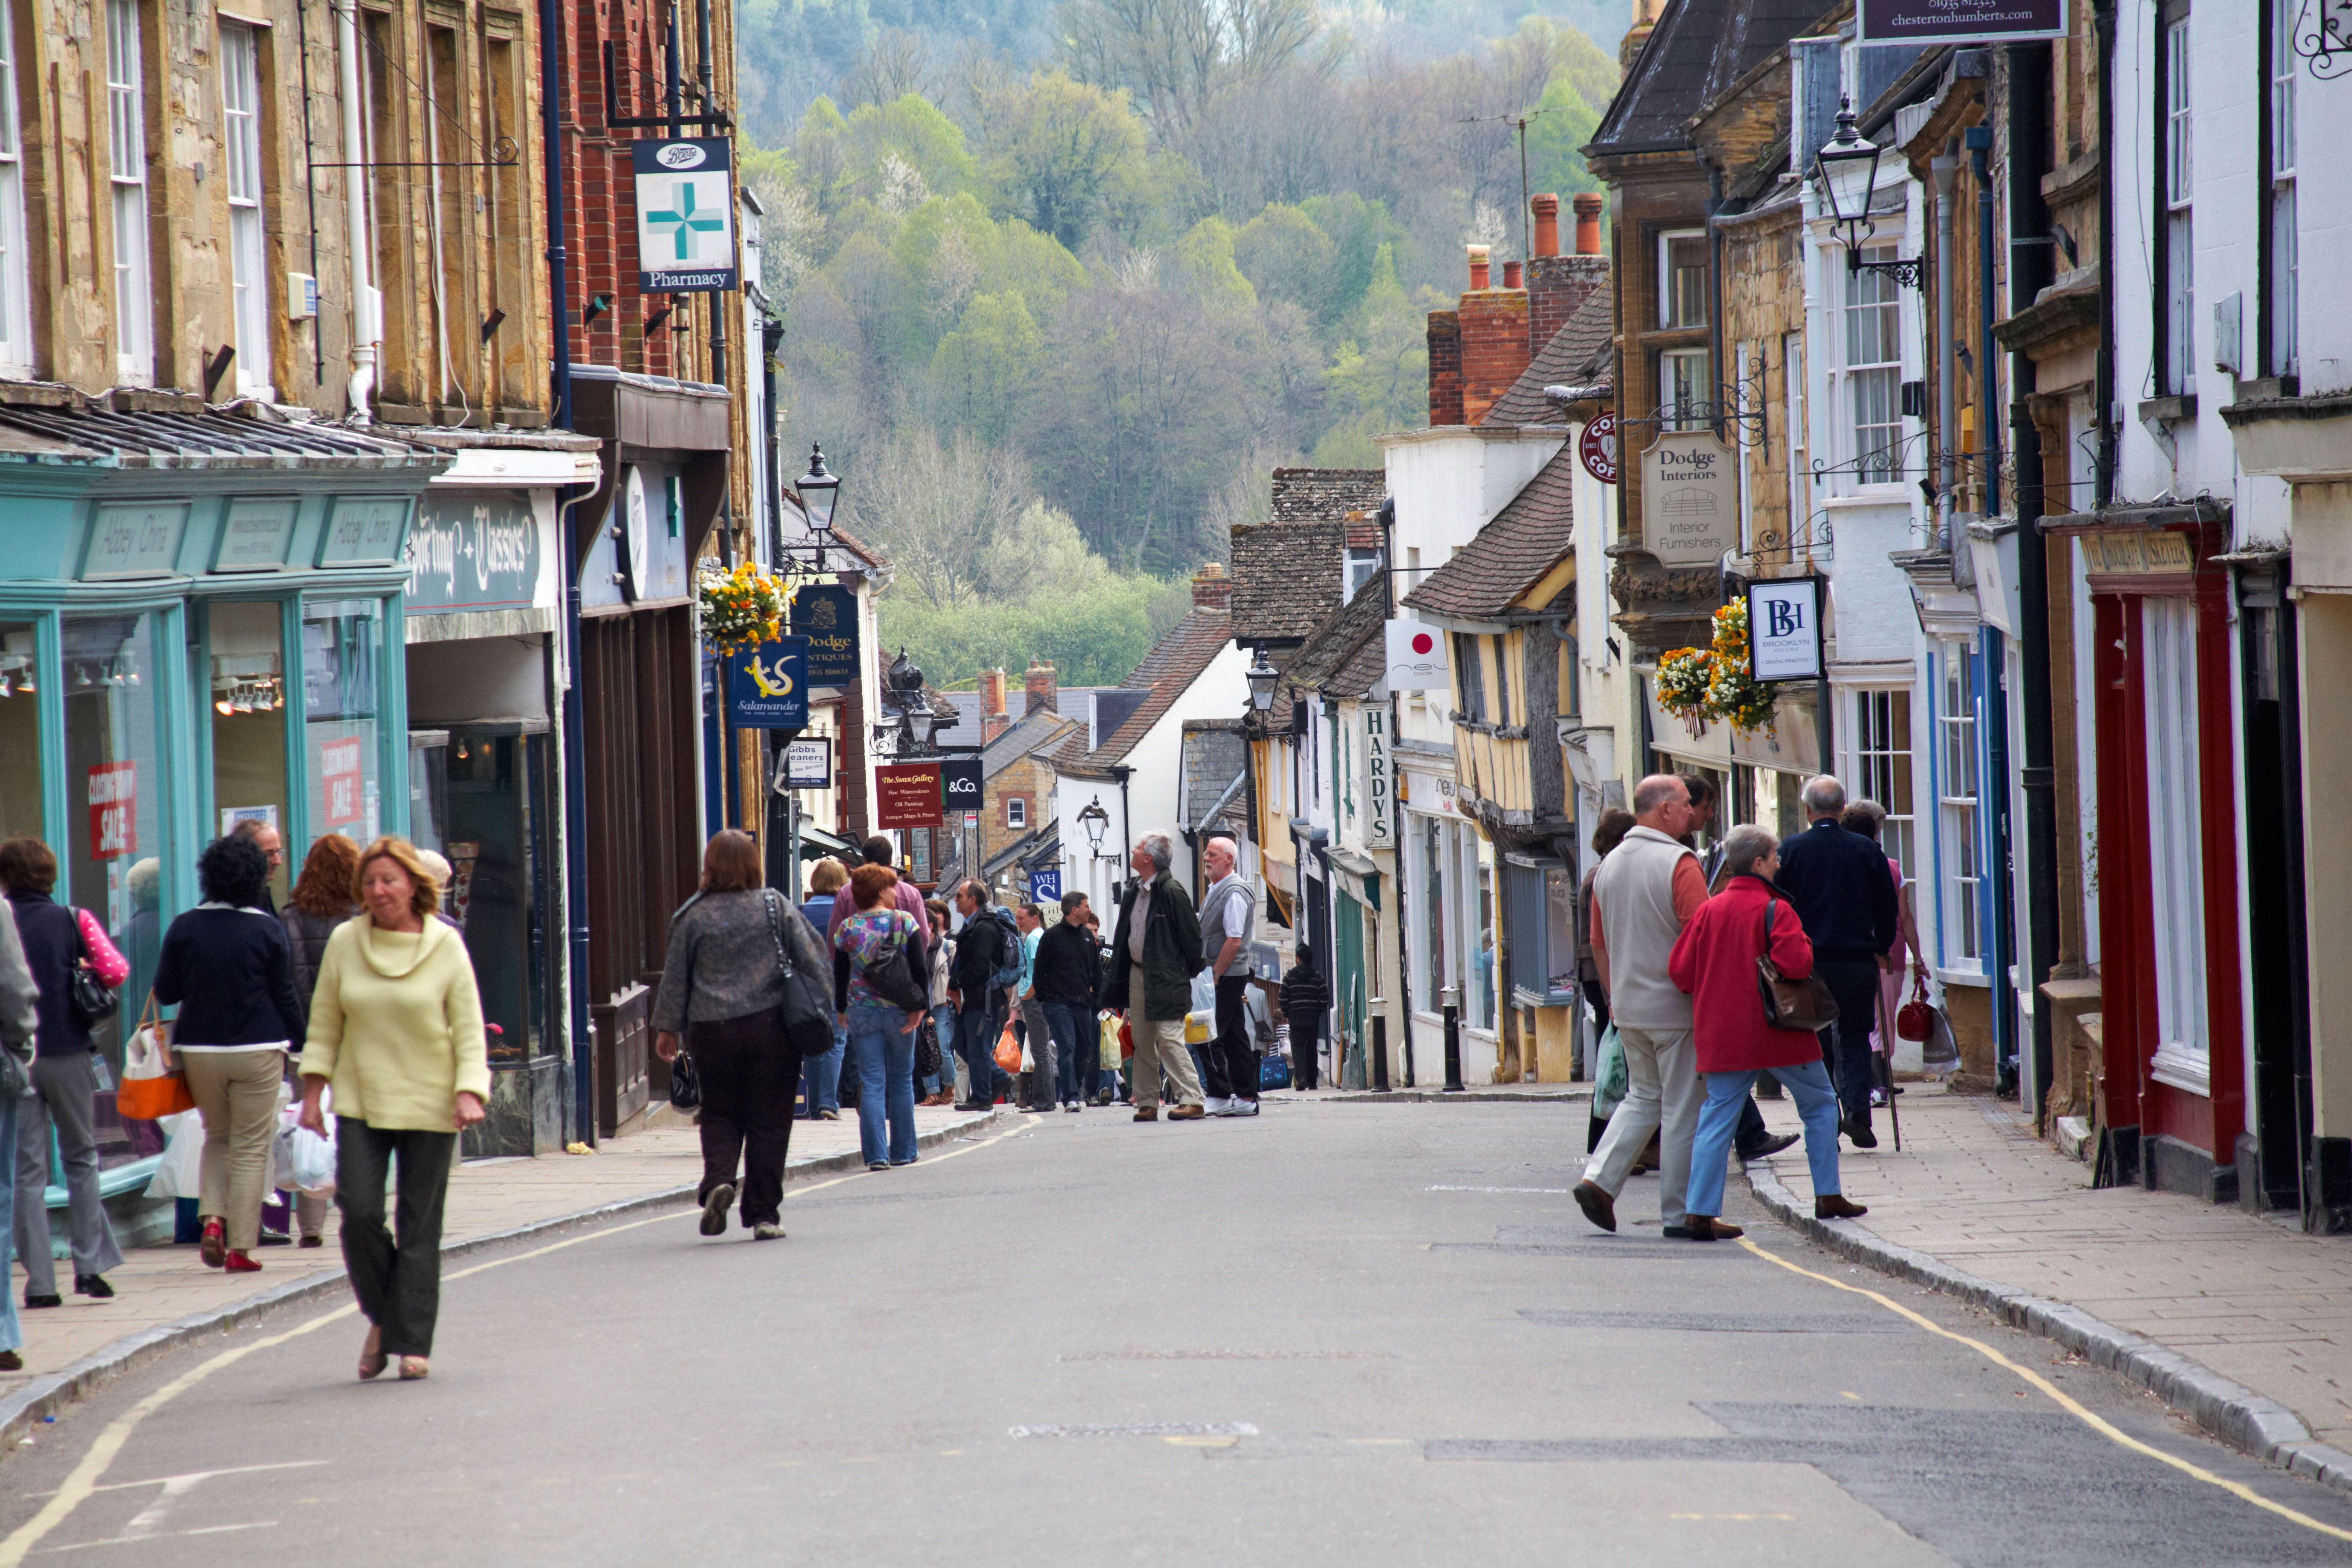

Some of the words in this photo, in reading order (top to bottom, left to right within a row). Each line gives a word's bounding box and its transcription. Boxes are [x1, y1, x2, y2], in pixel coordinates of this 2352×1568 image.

[1892, 10, 2033, 26] chestertonhumberts.com
[665, 147, 698, 164] Boots
[649, 272, 727, 288] Pharmacy
[1659, 448, 1716, 469] Dodge
[1660, 469, 1717, 481] Interiors
[1670, 522, 1710, 533] Interior
[1659, 537, 1721, 550] Furnishers
[738, 700, 800, 711] Salamander
[912, 774, 934, 784] Gallery
[1367, 712, 1387, 838] HARDYS
[331, 778, 351, 819] SALE
[100, 807, 125, 851] SALE
[1035, 874, 1056, 884] WH
